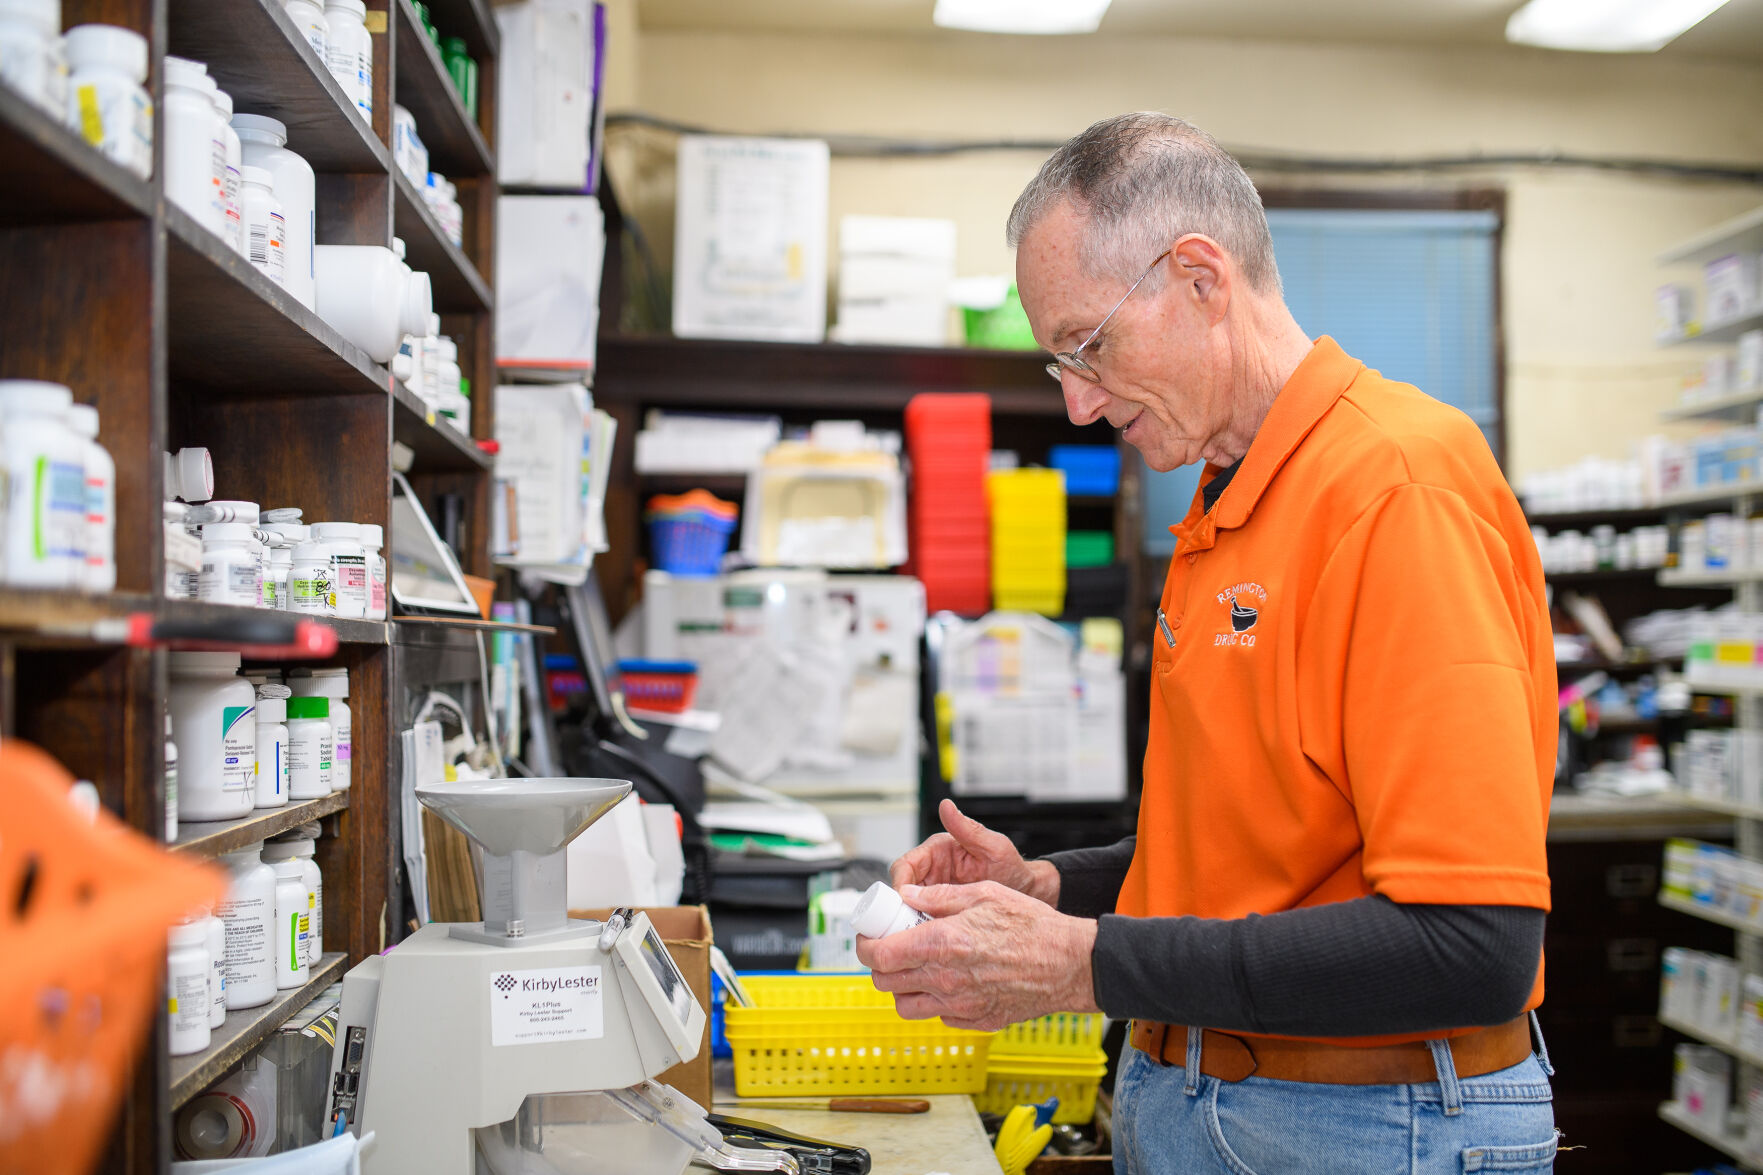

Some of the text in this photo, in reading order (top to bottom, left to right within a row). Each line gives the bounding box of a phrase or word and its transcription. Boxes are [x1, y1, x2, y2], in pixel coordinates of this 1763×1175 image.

[1216, 582, 1267, 604] REMINGTON
[1214, 632, 1256, 647] DRUG CO
[522, 976, 599, 992] KirbyLester
